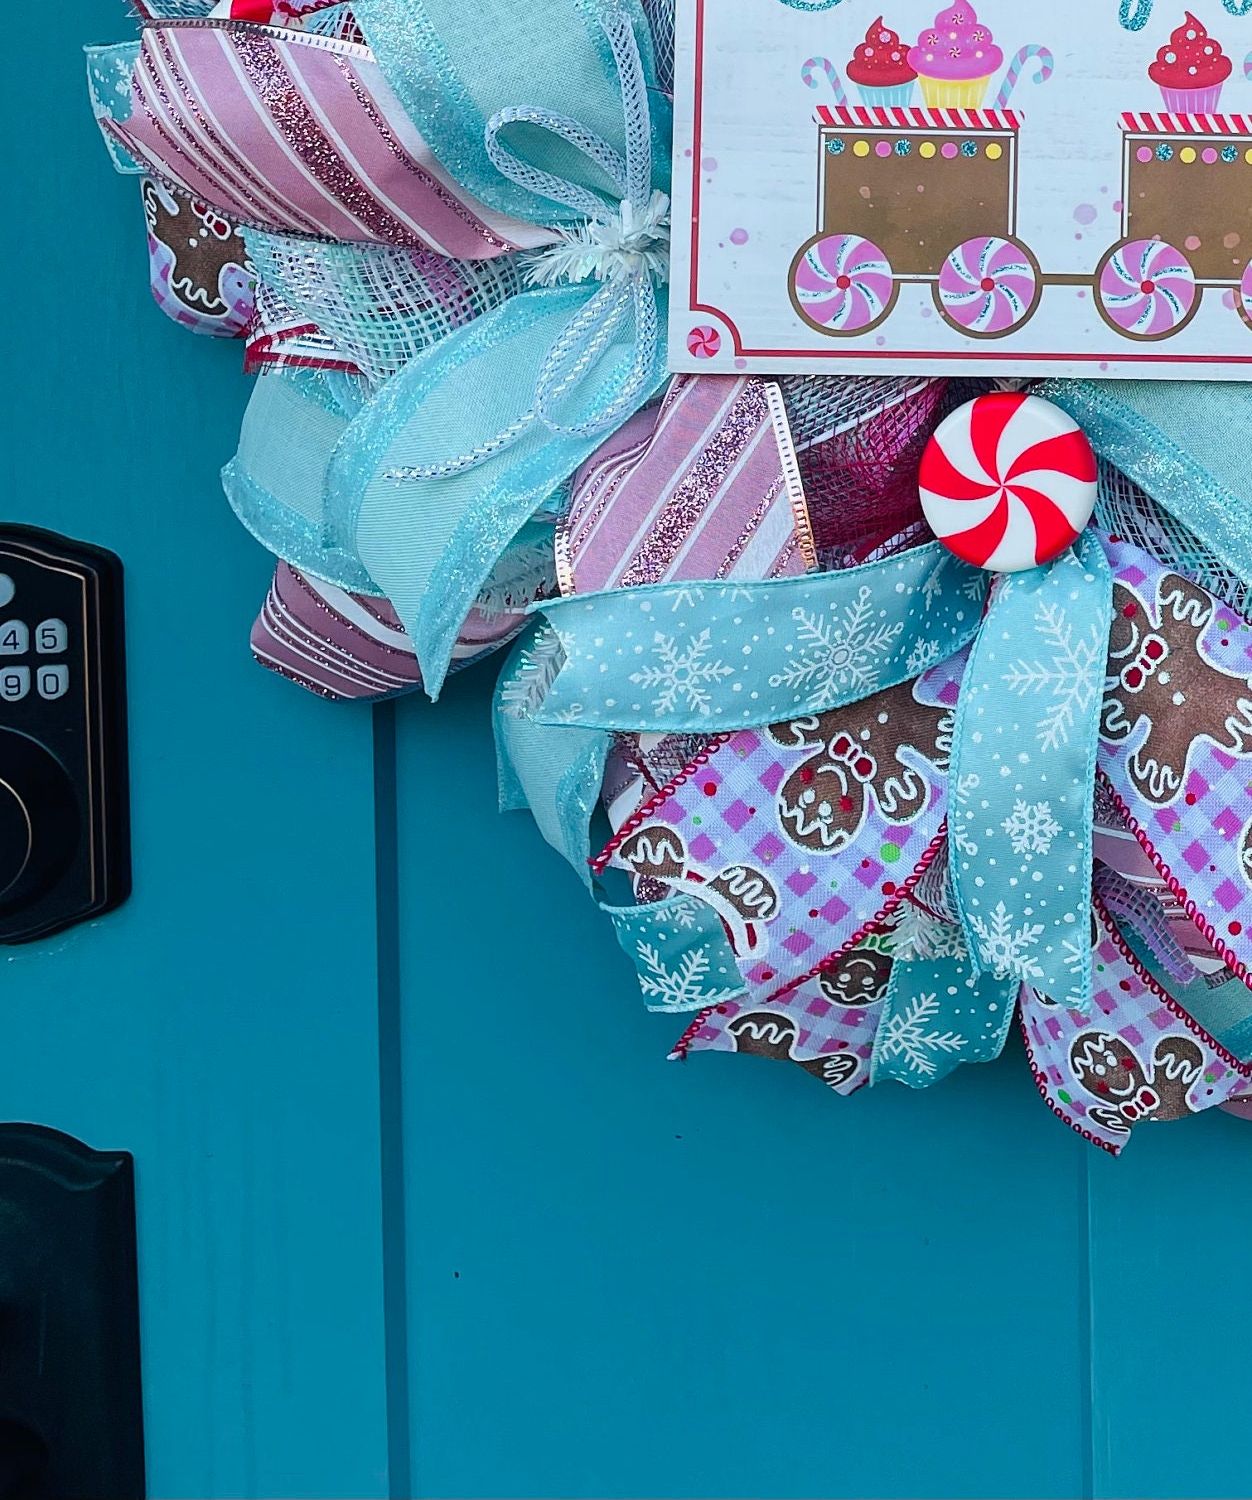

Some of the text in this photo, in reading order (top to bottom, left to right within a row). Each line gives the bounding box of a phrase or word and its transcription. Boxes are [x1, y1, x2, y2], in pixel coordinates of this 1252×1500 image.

[2, 628, 57, 650] 4 5
[4, 673, 59, 696] 9 0
